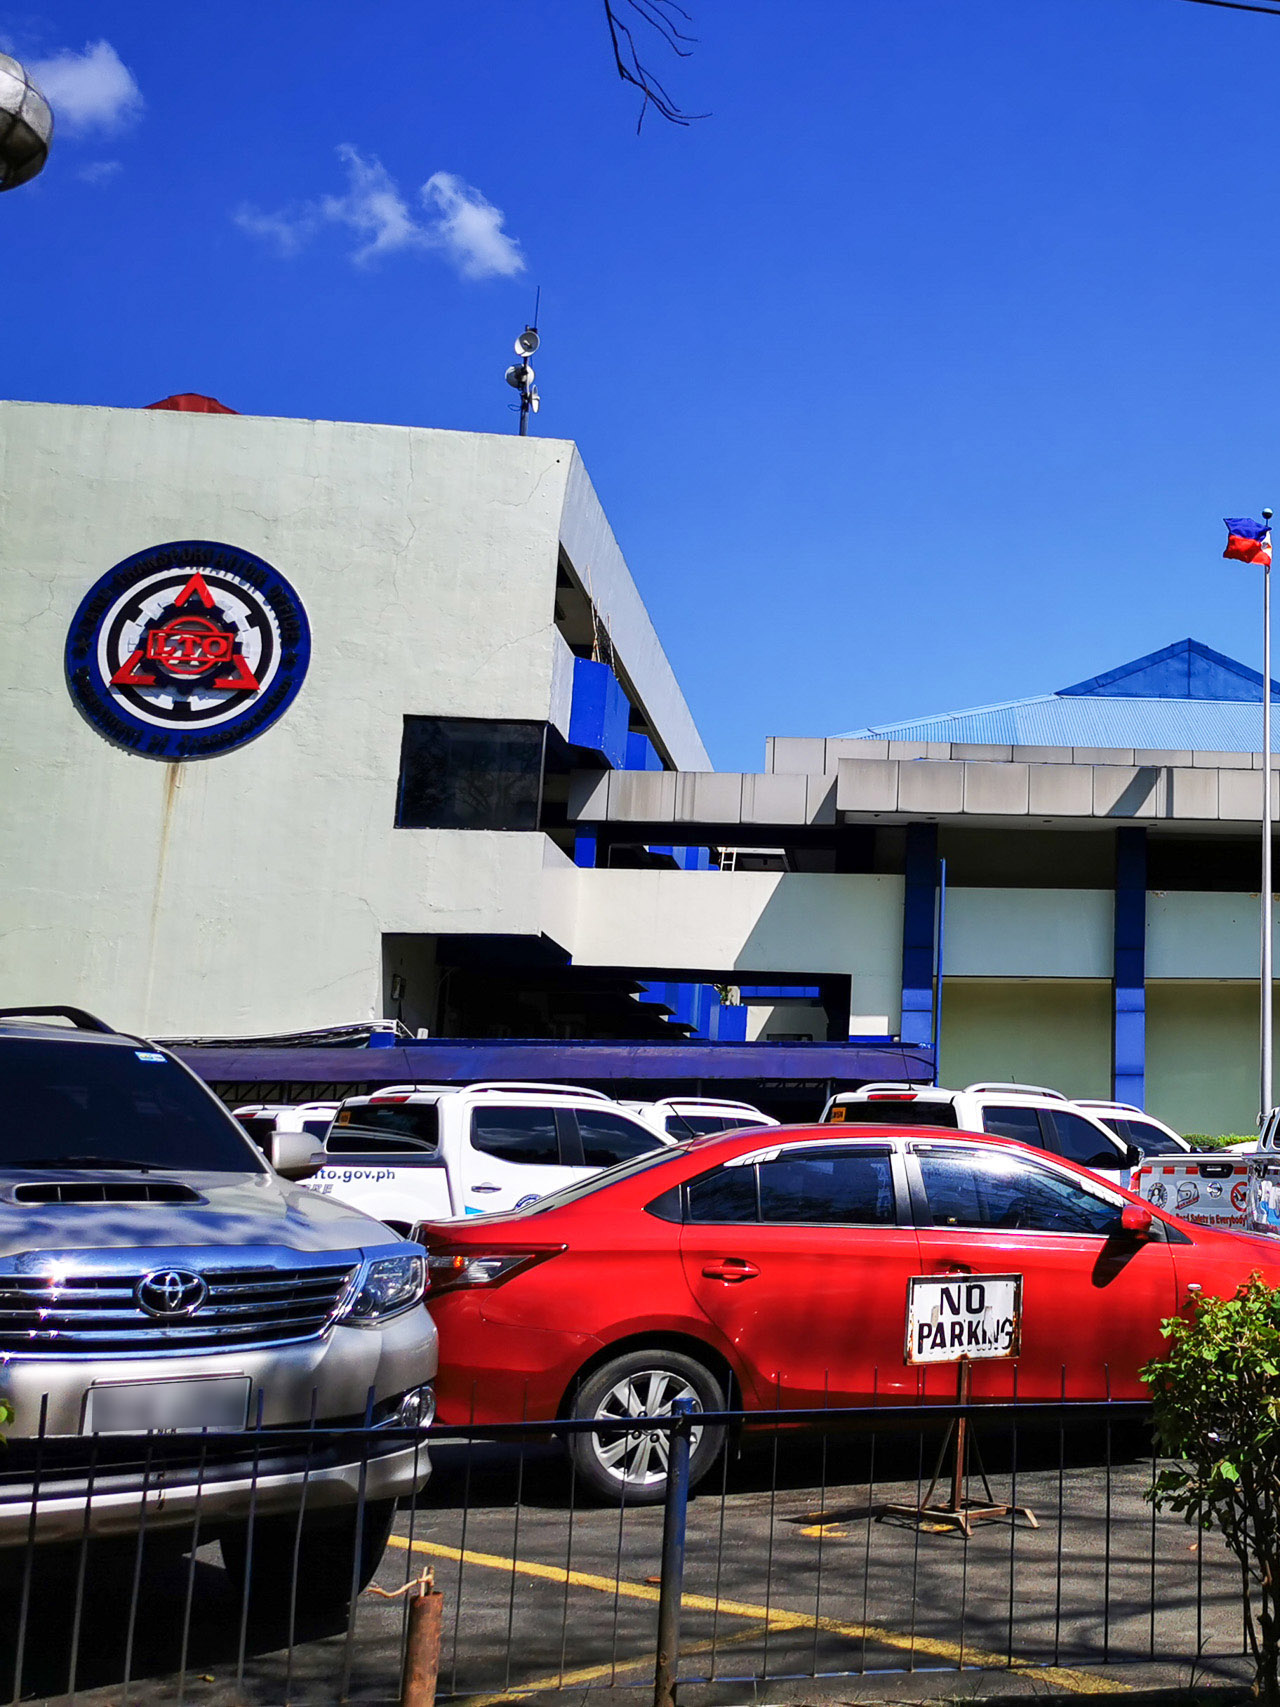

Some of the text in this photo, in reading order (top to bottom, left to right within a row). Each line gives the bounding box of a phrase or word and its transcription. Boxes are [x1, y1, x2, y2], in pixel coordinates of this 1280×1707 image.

[110, 547, 269, 590] TRANSPORTATION
[266, 585, 300, 649] OFFICE
[155, 634, 228, 656] LTO
[1216, 1214, 1248, 1227] Everybody'
[940, 1284, 985, 1316] NO
[917, 1318, 1014, 1354] PARKING
